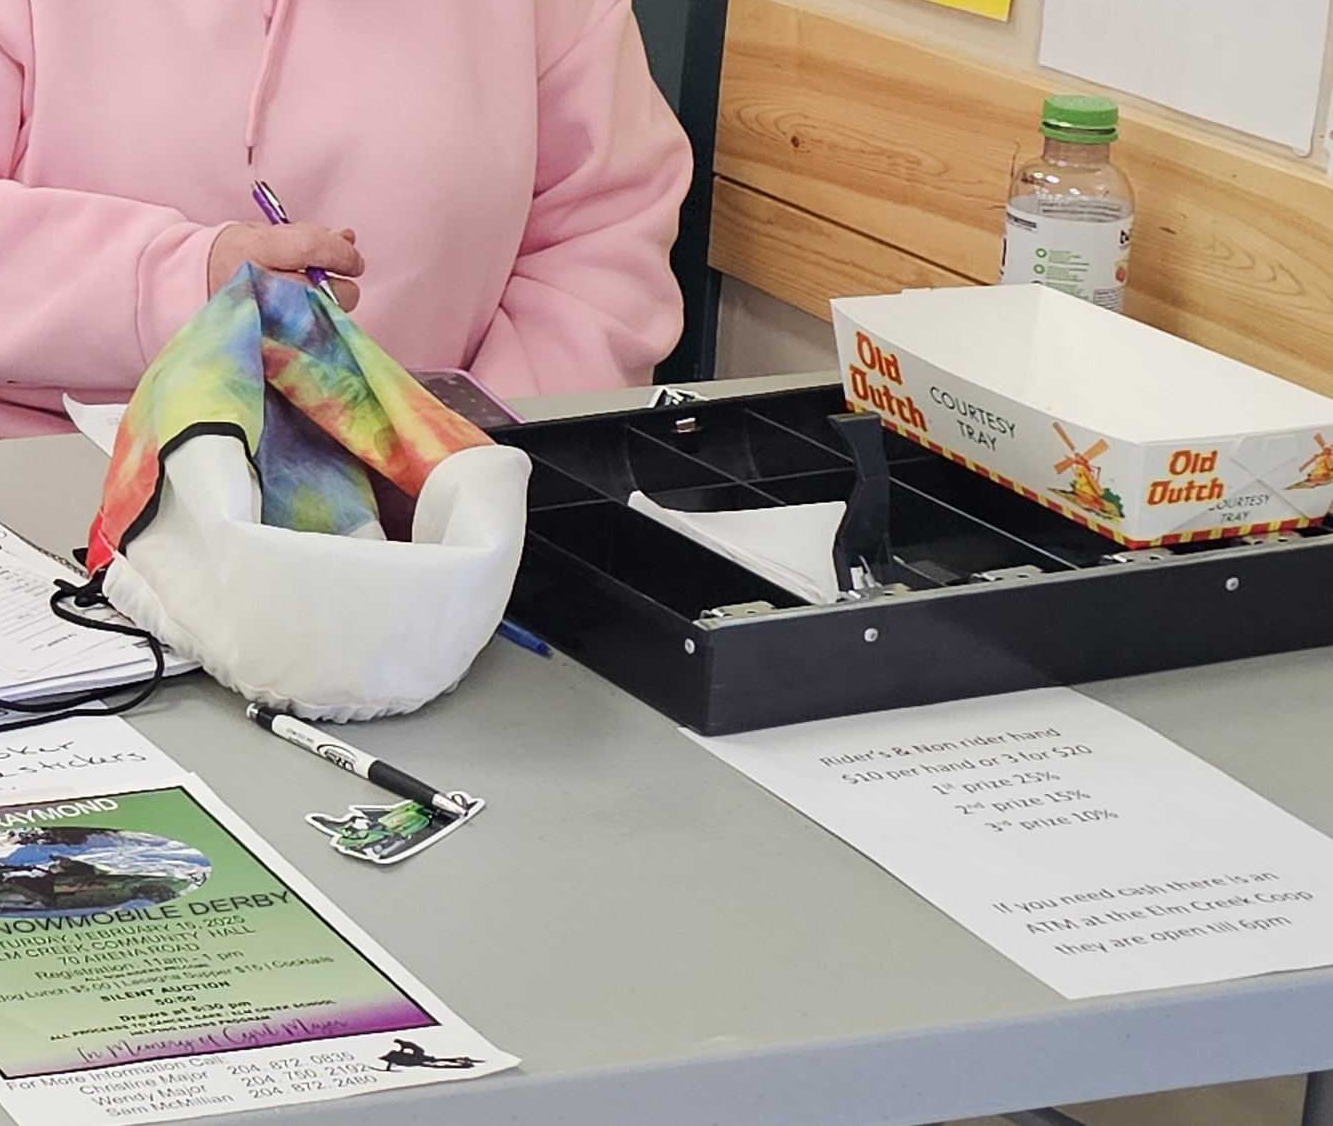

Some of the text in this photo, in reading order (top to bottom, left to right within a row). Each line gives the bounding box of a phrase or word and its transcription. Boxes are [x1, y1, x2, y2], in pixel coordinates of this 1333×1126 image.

[856, 331, 902, 386] Old
[850, 364, 928, 432] Dutch
[930, 387, 1015, 438] COURTESY
[957, 420, 998, 452] TRAY
[1169, 449, 1218, 475] Old
[1147, 478, 1225, 506] Dutch
[1219, 510, 1250, 523] TRAY
[892, 745, 911, 756] &
[913, 739, 959, 756] Non
[962, 734, 1006, 749] rider
[1011, 727, 1061, 743] hand
[841, 743, 1094, 786] $10 per hand or 3 for $20
[962, 776, 1013, 795] prize
[1017, 770, 1061, 786] 25%
[992, 795, 1041, 814] prize
[1045, 789, 1091, 804] 15%
[1019, 815, 1071, 832] prize
[1073, 809, 1119, 823] 10%
[188, 890, 292, 916] DERBY
[1017, 897, 1059, 914] you
[1063, 887, 1115, 907] need
[1118, 880, 1165, 898] cash
[1167, 875, 1221, 892] there
[1225, 873, 1246, 884] is
[1250, 871, 1279, 883] an
[1025, 888, 1314, 936] ATM at the Elm Creek Coop
[24, 943, 91, 959] CREEK
[91, 931, 199, 952] COMMUNITY
[207, 926, 257, 938] HALL
[75, 924, 172, 942] FEBRUARY
[206, 916, 245, 925] 2025
[1054, 914, 1292, 958] they are open till 6pm
[59, 942, 201, 966] 70 ARENA ROAD
[100, 981, 231, 1002] SILENT AUCTION
[119, 1009, 171, 1022] Draws
[229, 1001, 252, 1009] pm
